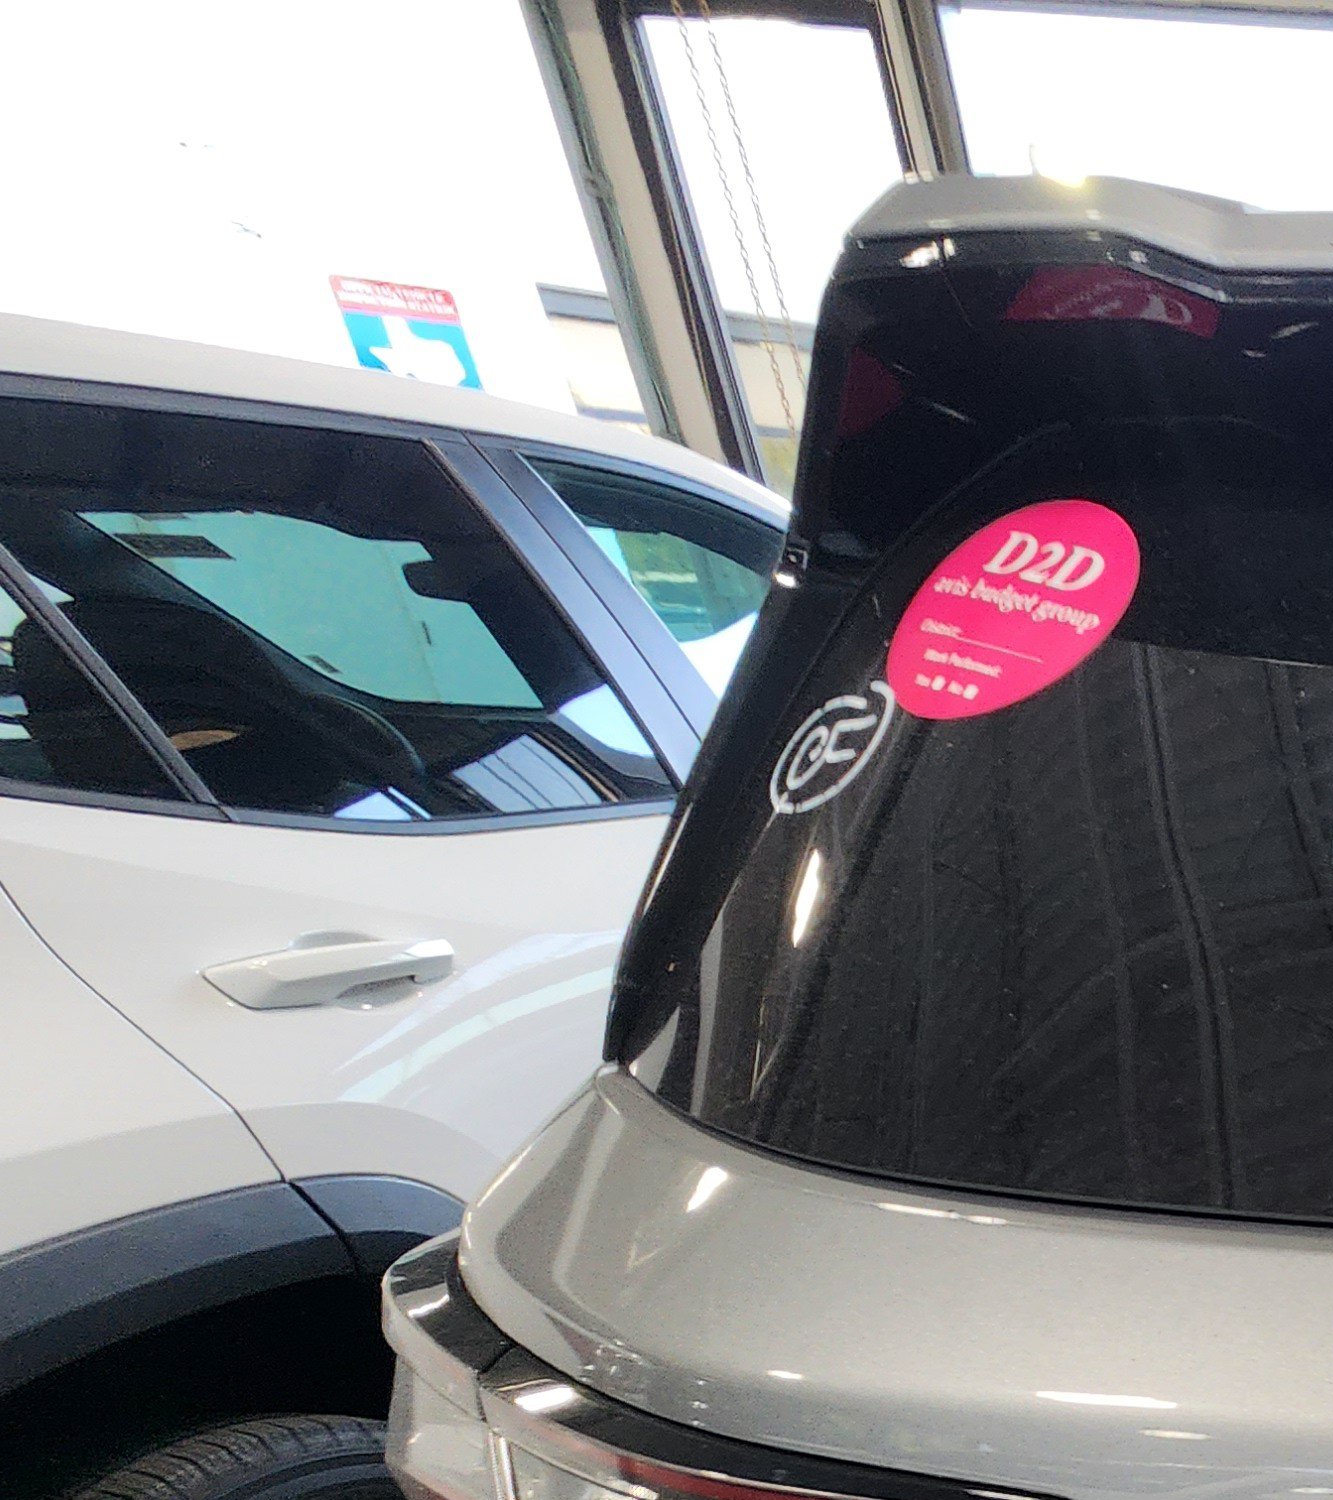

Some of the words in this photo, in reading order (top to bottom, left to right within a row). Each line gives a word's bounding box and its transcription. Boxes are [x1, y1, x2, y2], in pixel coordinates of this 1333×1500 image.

[982, 530, 1105, 591] D2D
[970, 577, 1041, 613] budget
[1031, 600, 1100, 635] group
